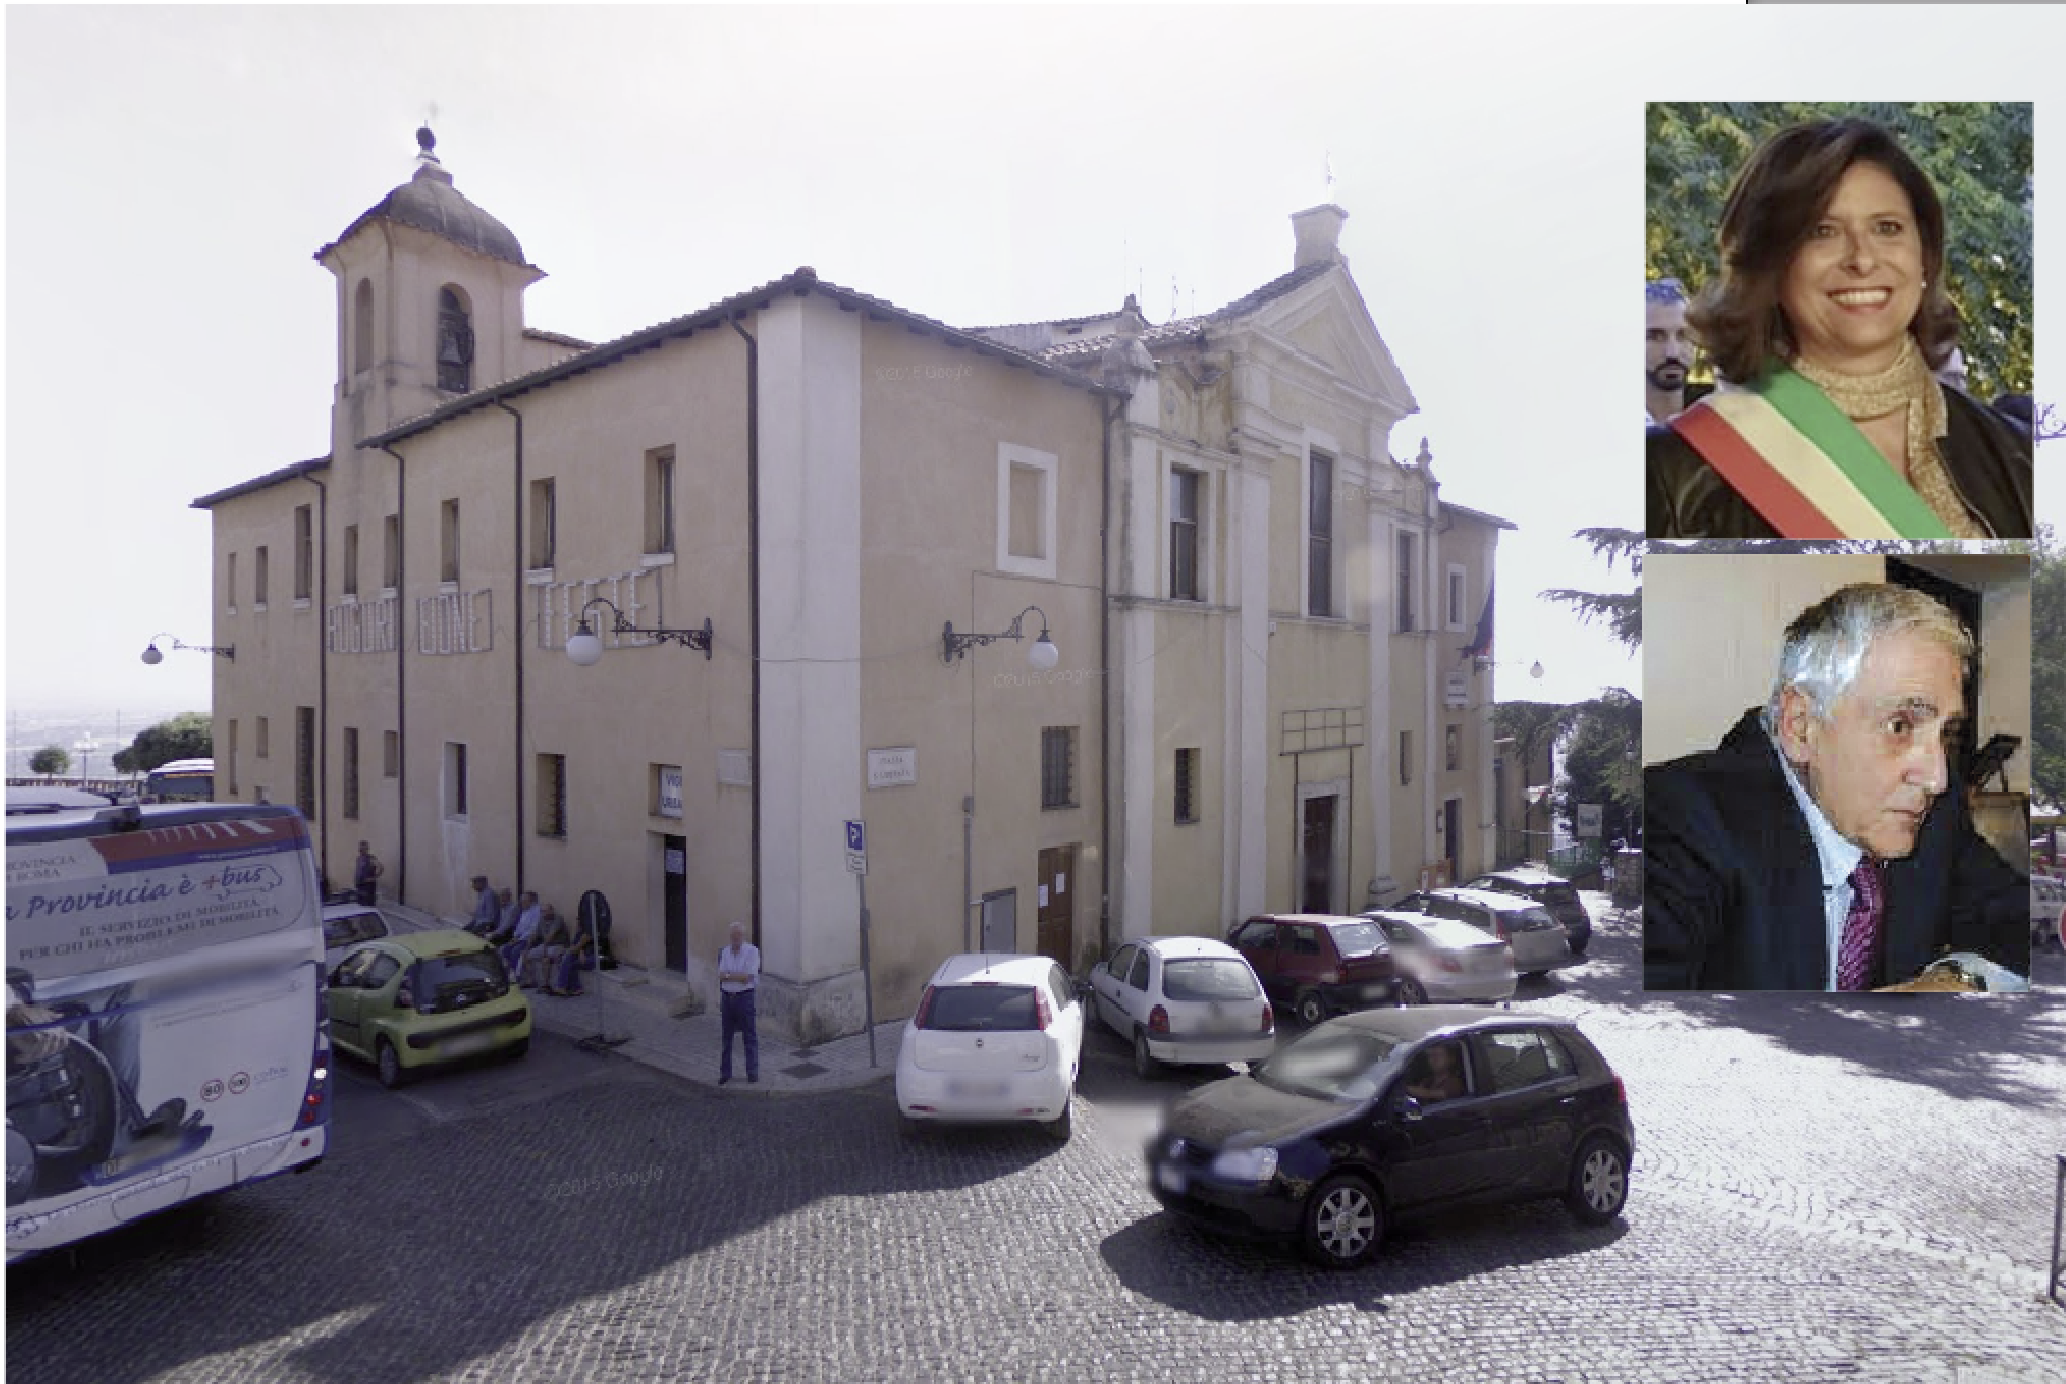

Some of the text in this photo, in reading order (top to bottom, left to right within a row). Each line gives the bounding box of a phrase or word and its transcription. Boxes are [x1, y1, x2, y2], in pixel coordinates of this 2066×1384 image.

[26, 877, 174, 919] Provincia
[177, 873, 197, 896] è
[55, 941, 83, 956] CHI
[87, 937, 113, 950] HA
[115, 921, 197, 946] PROBLEMI
[98, 915, 172, 933] SERVIZIO
[175, 911, 191, 923] DI
